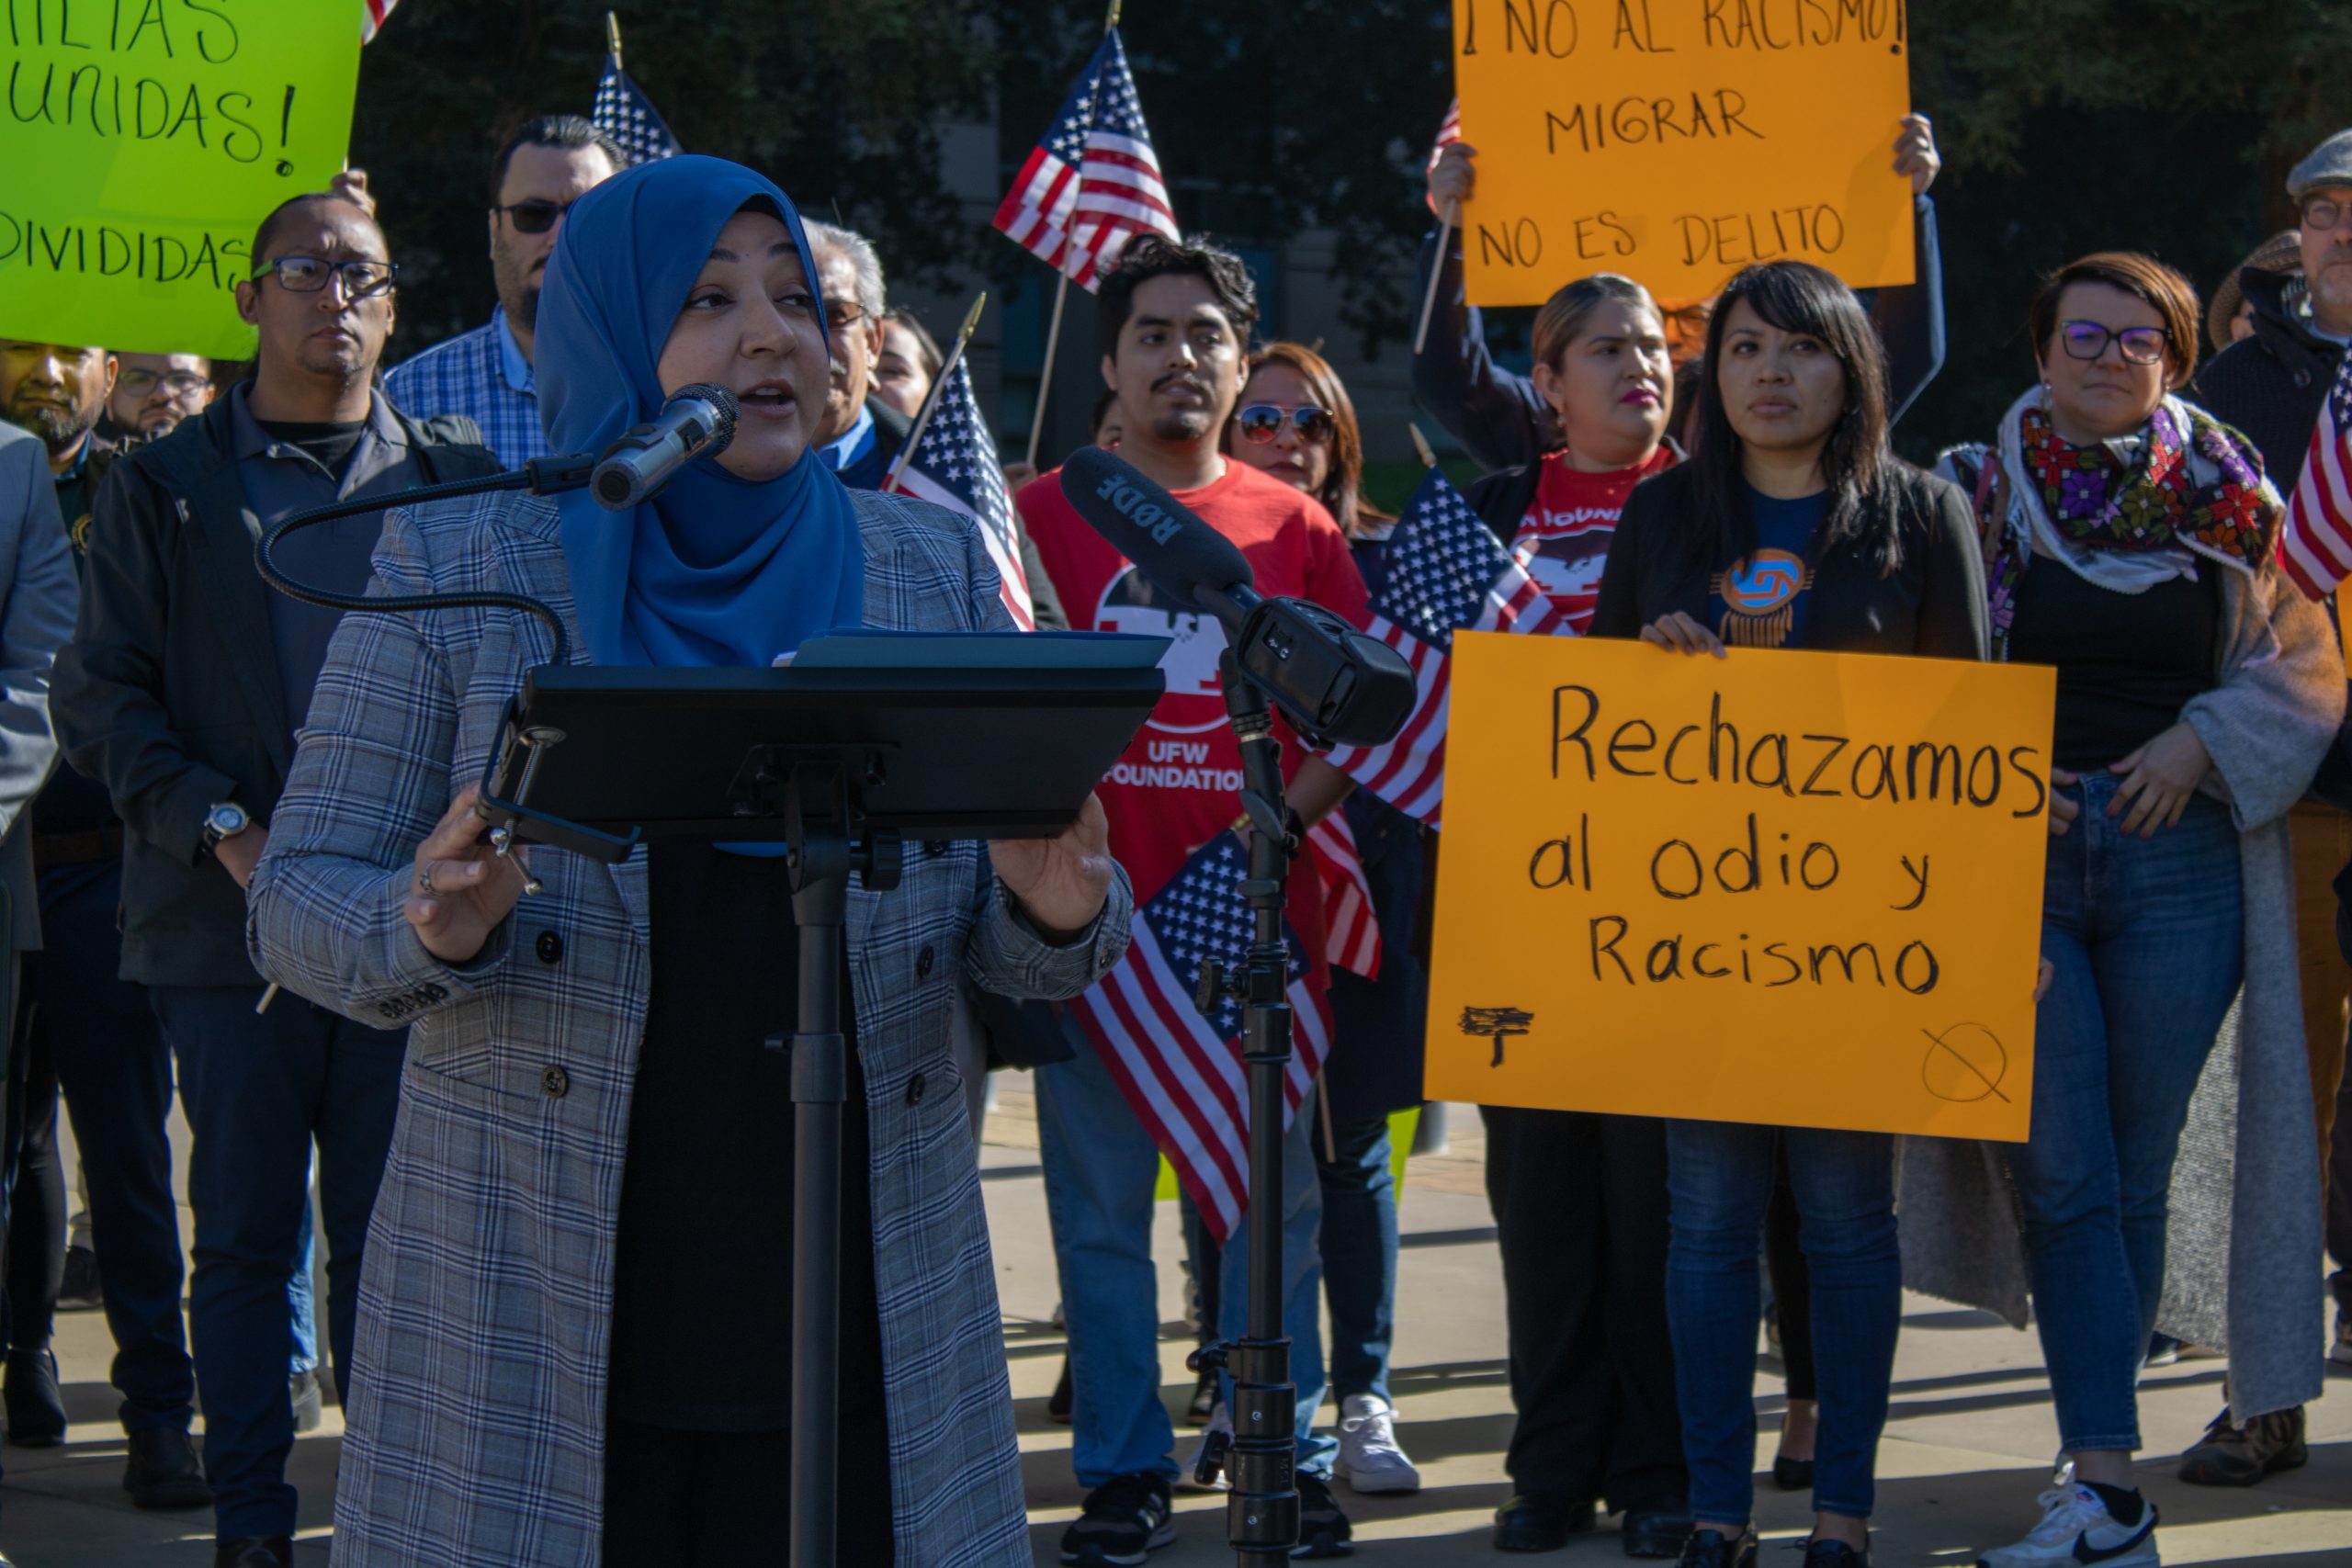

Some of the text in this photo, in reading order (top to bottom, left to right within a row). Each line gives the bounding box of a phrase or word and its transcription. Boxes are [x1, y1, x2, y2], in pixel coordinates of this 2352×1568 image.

[1613, 0, 1675, 53] AL
[1545, 89, 1766, 154] MIGRAR
[1479, 203, 1846, 268] NO ES DELITO
[1148, 740, 1210, 765] UFW
[1551, 684, 2048, 820] Rechazamos
[1528, 812, 1592, 892] al
[1889, 852, 1930, 911] y
[1589, 914, 1941, 996] Racismo
